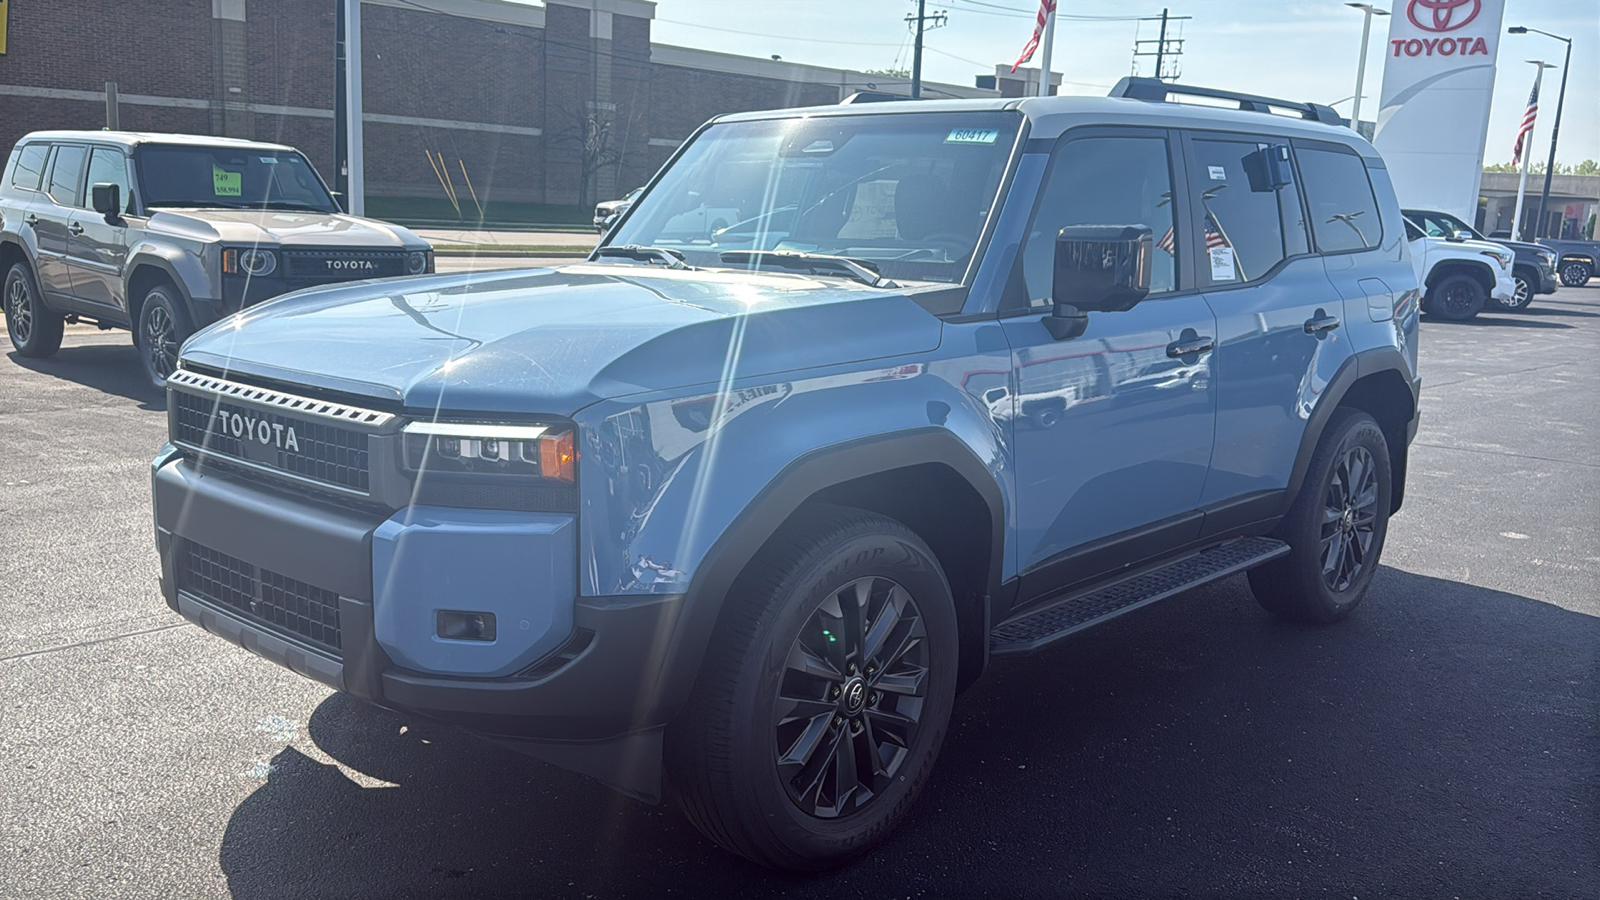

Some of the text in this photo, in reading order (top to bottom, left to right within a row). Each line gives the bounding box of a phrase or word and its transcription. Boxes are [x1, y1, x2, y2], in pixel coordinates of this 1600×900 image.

[1391, 37, 1488, 57] TOYOTA
[955, 130, 991, 140] 60417
[326, 260, 373, 269] TOYOTA
[219, 410, 299, 452] TOYOTA
